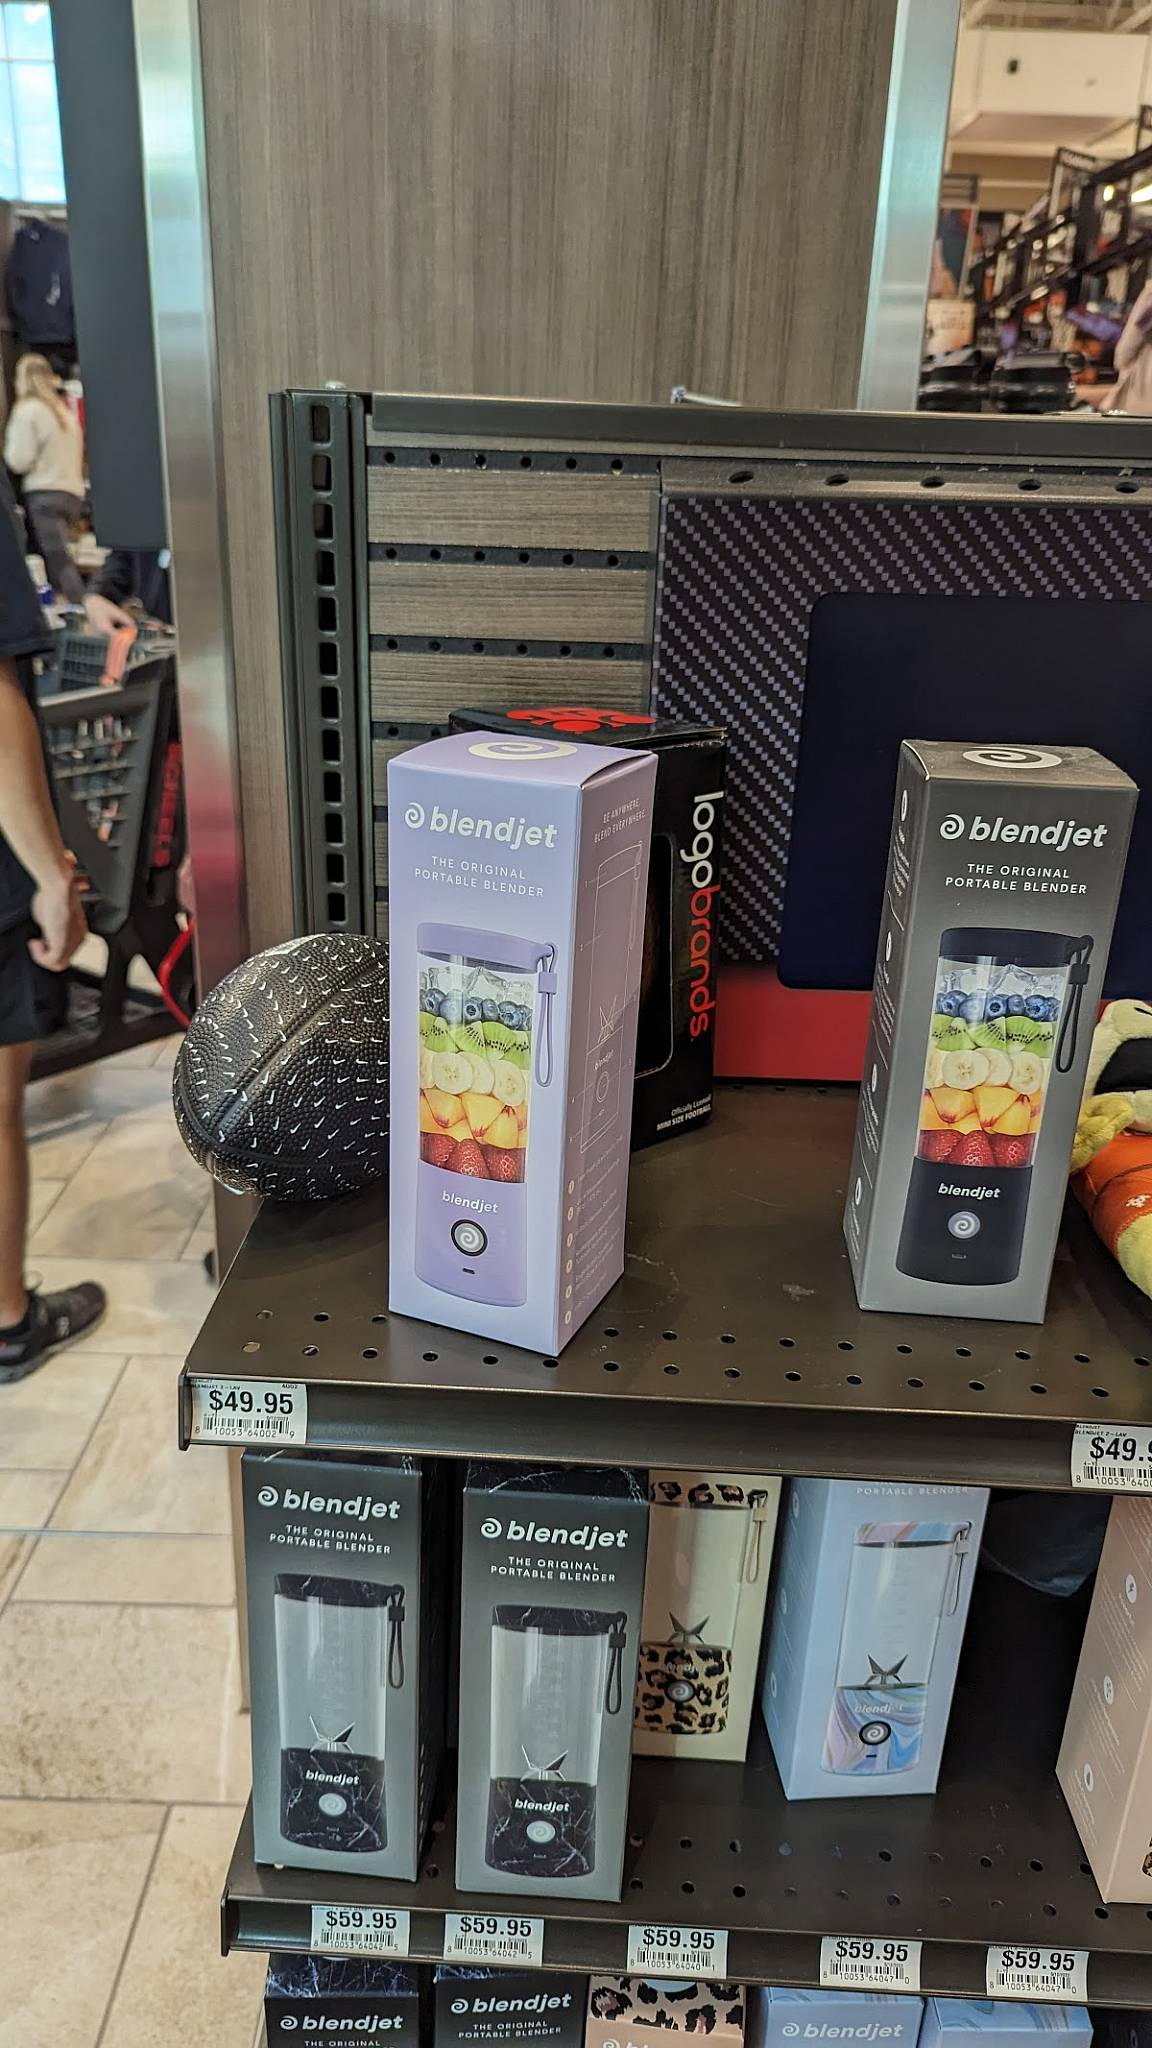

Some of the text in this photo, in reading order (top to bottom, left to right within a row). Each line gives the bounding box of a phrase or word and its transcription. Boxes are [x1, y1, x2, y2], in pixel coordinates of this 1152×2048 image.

[430, 805, 558, 850] blendjet
[968, 815, 1108, 852] blendjet
[432, 855, 526, 880] THE ORIGINAL
[967, 863, 1070, 879] THE ORIGINAL
[415, 868, 545, 898] PORTABLE BLENDER
[945, 876, 1088, 895] PORTABLE BLENDER
[680, 790, 724, 1037] logobrands
[656, 1103, 711, 1131] MINI SIZE FOOTBALL
[938, 1182, 1000, 1200] blendjet
[442, 1190, 499, 1214] blendjet
[209, 1389, 294, 1415] $49.95
[194, 1425, 295, 1438] 8 10053 64002 9
[1076, 1474, 1082, 1483] 8
[1096, 1476, 1126, 1486] 10053
[856, 1487, 913, 1497] PORTABLE
[282, 1488, 401, 1521] blendjet
[285, 1524, 375, 1542] THE ORIGINAL
[506, 1519, 629, 1551] blendjet
[269, 1533, 392, 1554] PORTABLE BLENDER
[491, 1564, 616, 1583] PORTABLE BLENDER
[508, 1556, 600, 1572] THE ORIGINAL
[305, 1769, 360, 1787] blendjet
[514, 1797, 571, 1815] blendjet
[326, 1910, 397, 1930] $59.95
[460, 1916, 532, 1937] $59.95
[330, 1940, 355, 1949] 10053
[393, 1943, 399, 1951] 5
[642, 1928, 715, 1950] $59.95
[447, 1945, 452, 1953] 8
[464, 1947, 489, 1956] 10053
[527, 1951, 533, 1959] 5
[835, 1940, 909, 1962] $59.95
[1001, 1949, 1076, 1971] $59.95
[647, 1960, 671, 1969] 10053
[839, 1972, 865, 1981] 10053
[868, 1974, 894, 1983] 64047
[904, 1976, 910, 1985] 0
[1006, 1983, 1032, 1992] 10053
[1035, 1985, 1061, 1993] 64047
[1071, 1986, 1077, 1994] 0
[473, 1991, 572, 2014] blendjet
[302, 2015, 404, 2033] blendjet
[458, 2026, 562, 2039] PORTABLE BLENDER
[473, 2020, 548, 2031] THE ORIGINAL
[802, 2022, 905, 2041] blendjet
